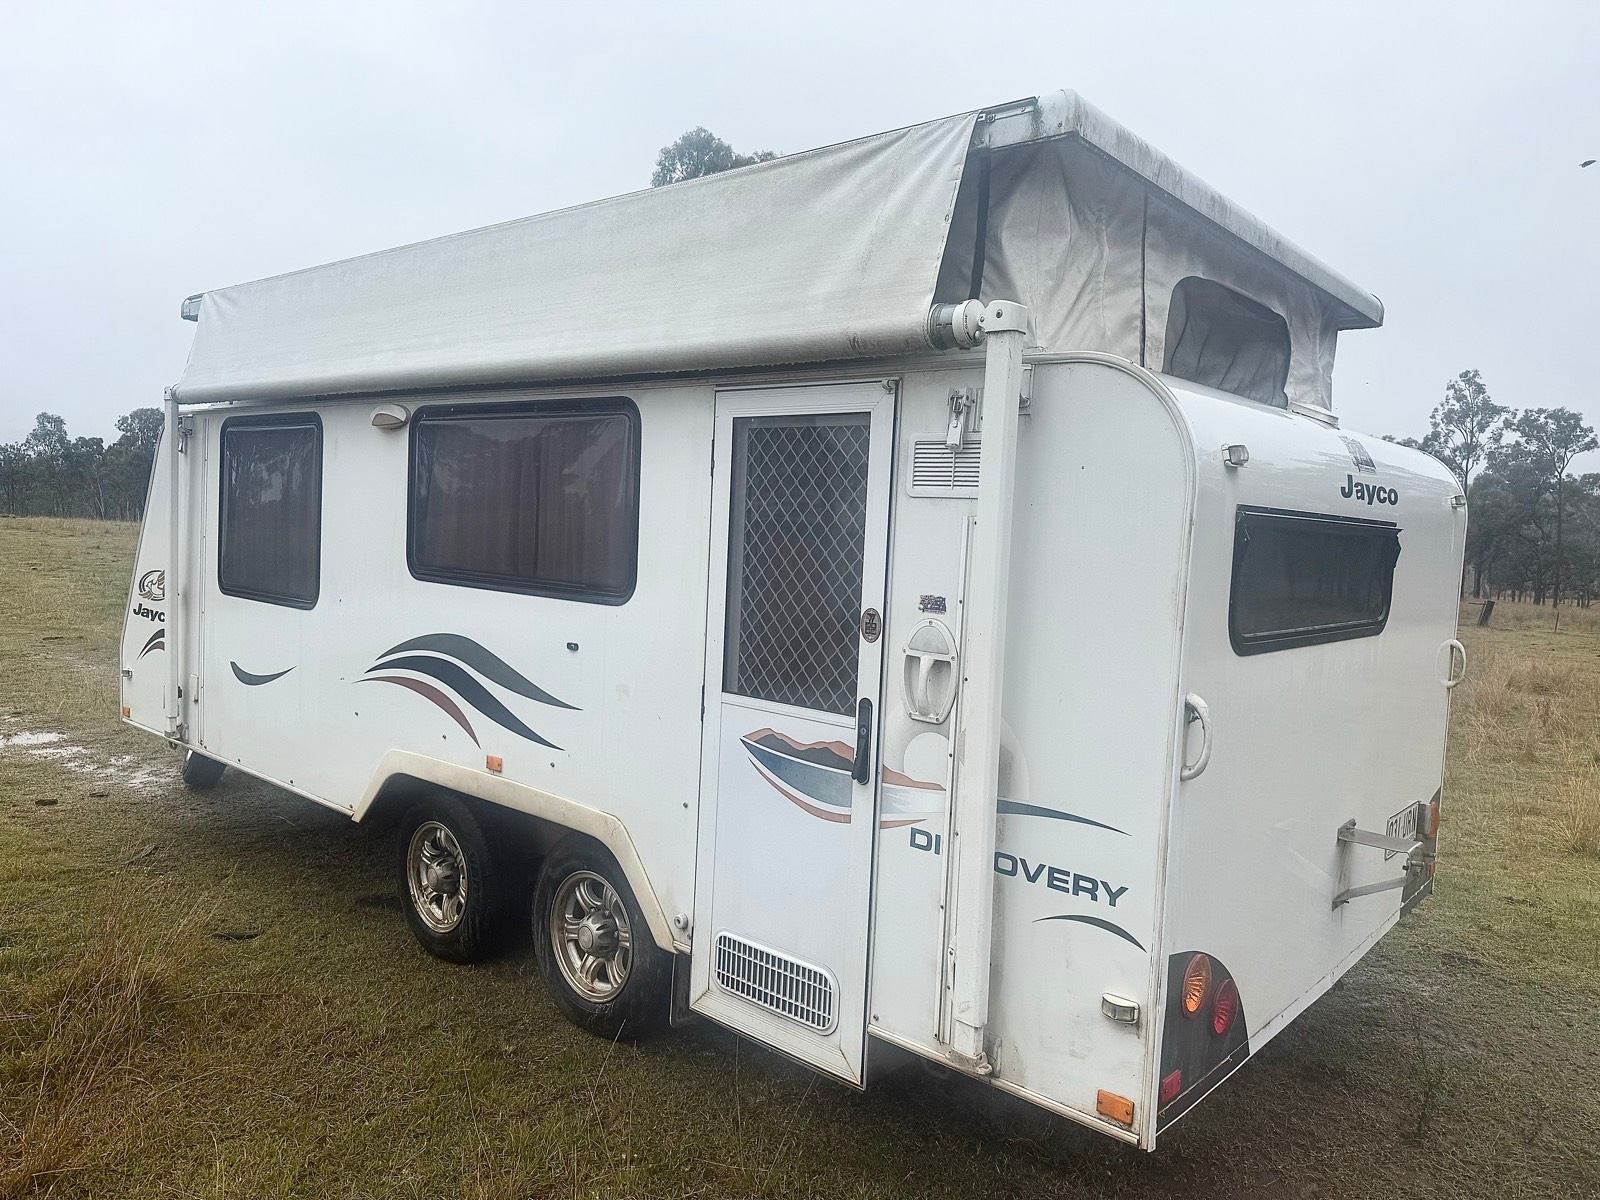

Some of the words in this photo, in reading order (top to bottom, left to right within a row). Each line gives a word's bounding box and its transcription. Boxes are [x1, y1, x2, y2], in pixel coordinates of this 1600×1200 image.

[1340, 474, 1398, 506] Jayco
[133, 603, 165, 622] Jayc
[909, 827, 1129, 907] DIOVERY
